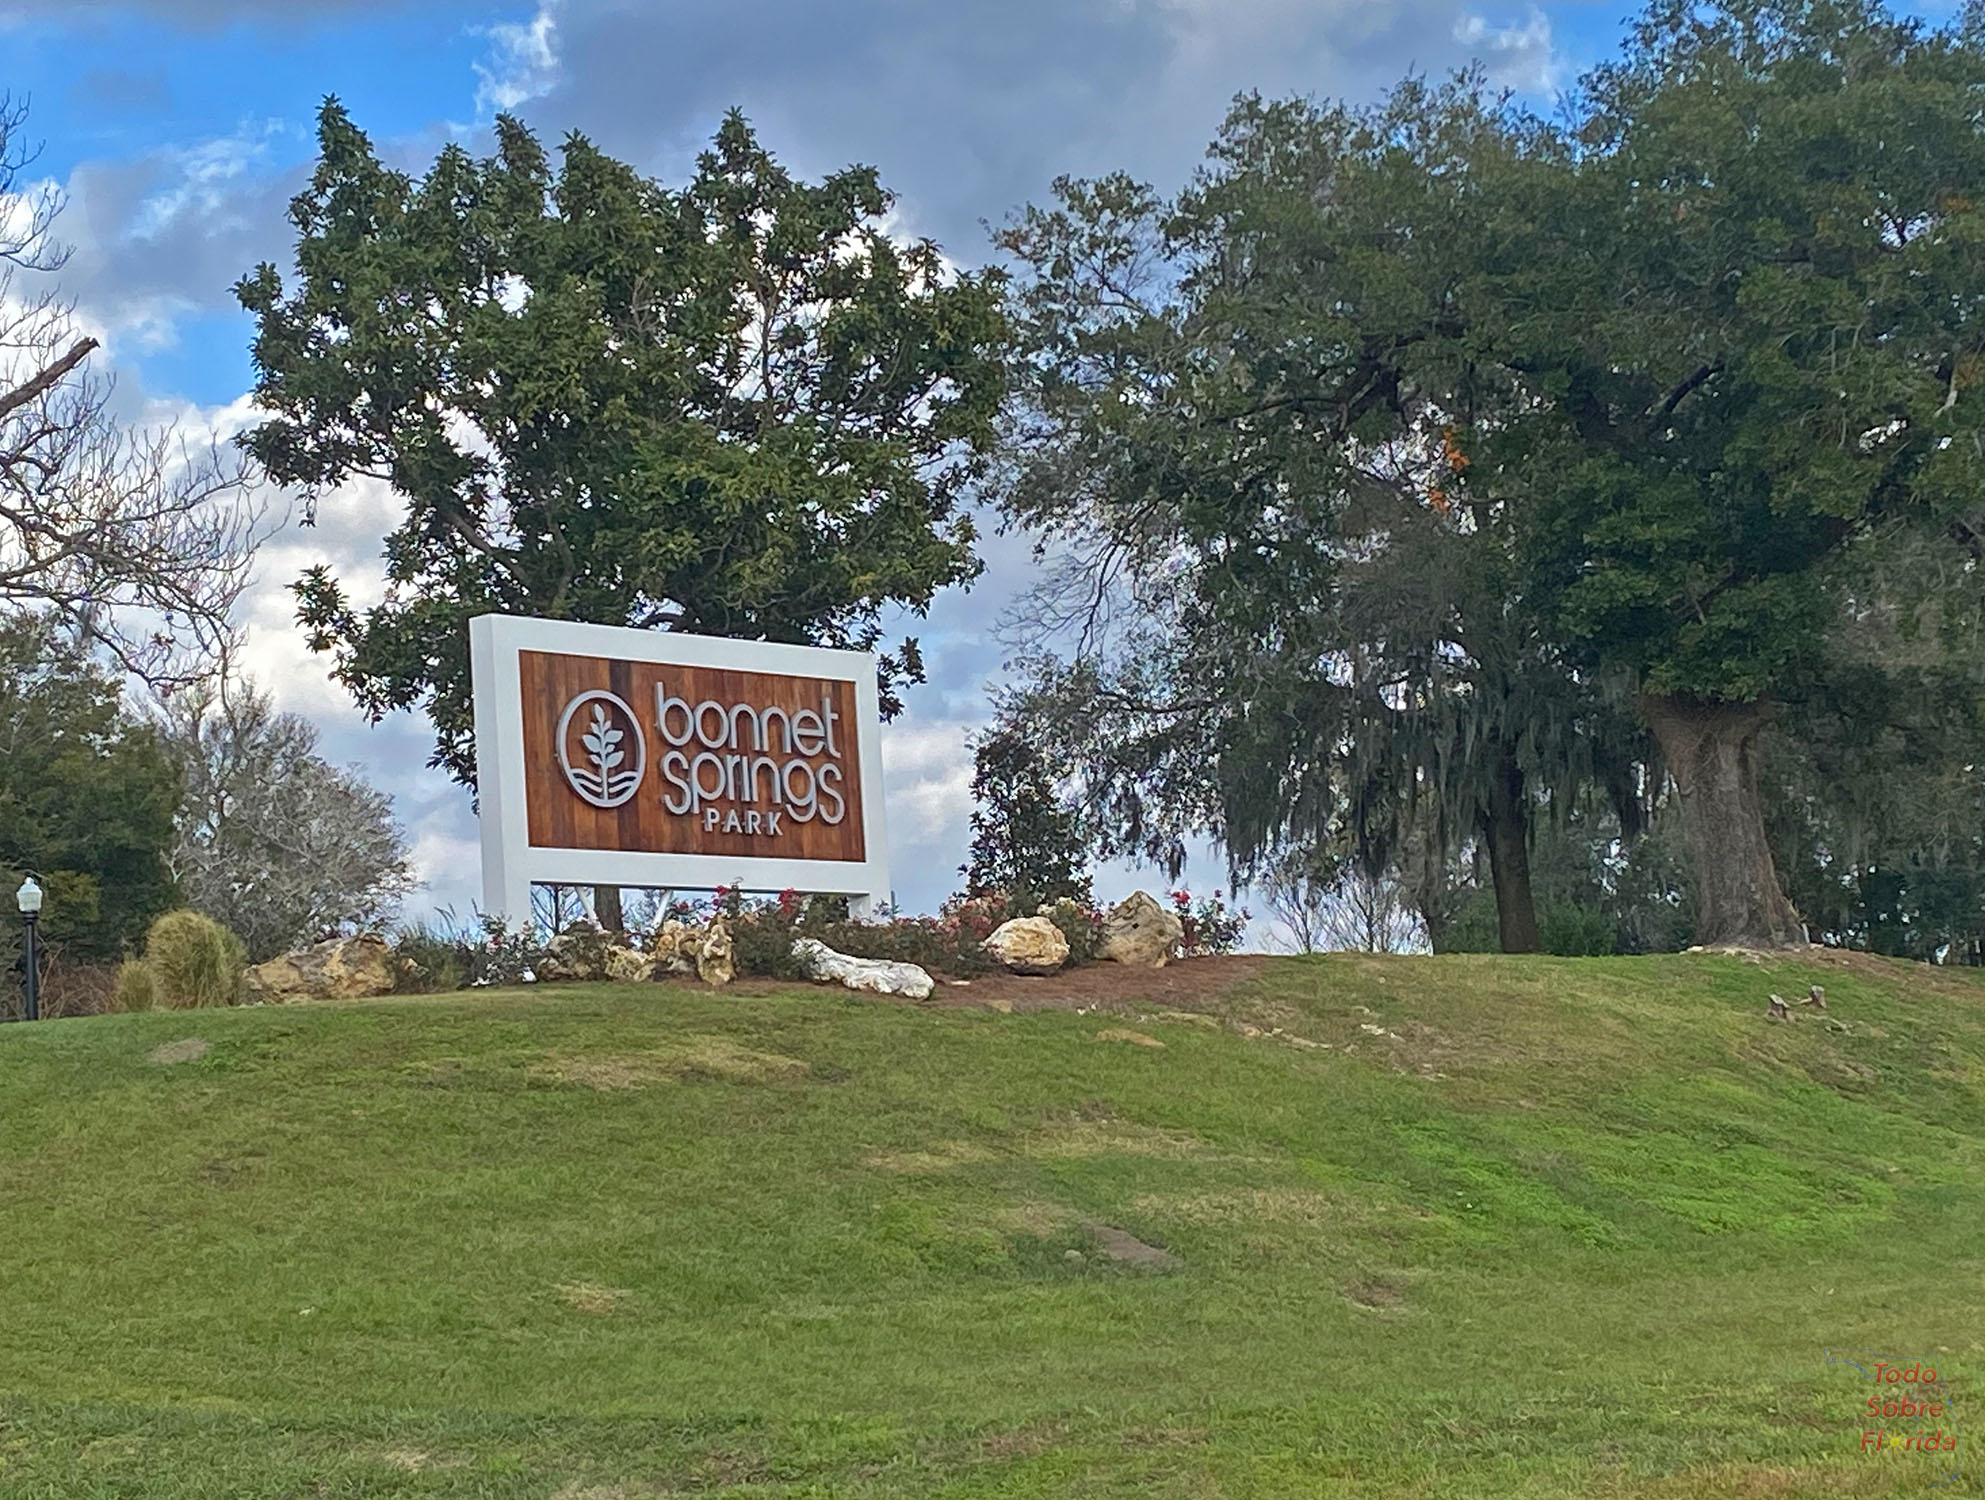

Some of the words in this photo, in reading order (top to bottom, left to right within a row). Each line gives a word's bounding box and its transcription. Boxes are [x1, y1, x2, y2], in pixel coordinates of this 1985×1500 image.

[654, 681, 841, 759] bonnet
[659, 751, 845, 825] springs
[703, 808, 784, 837] PARK
